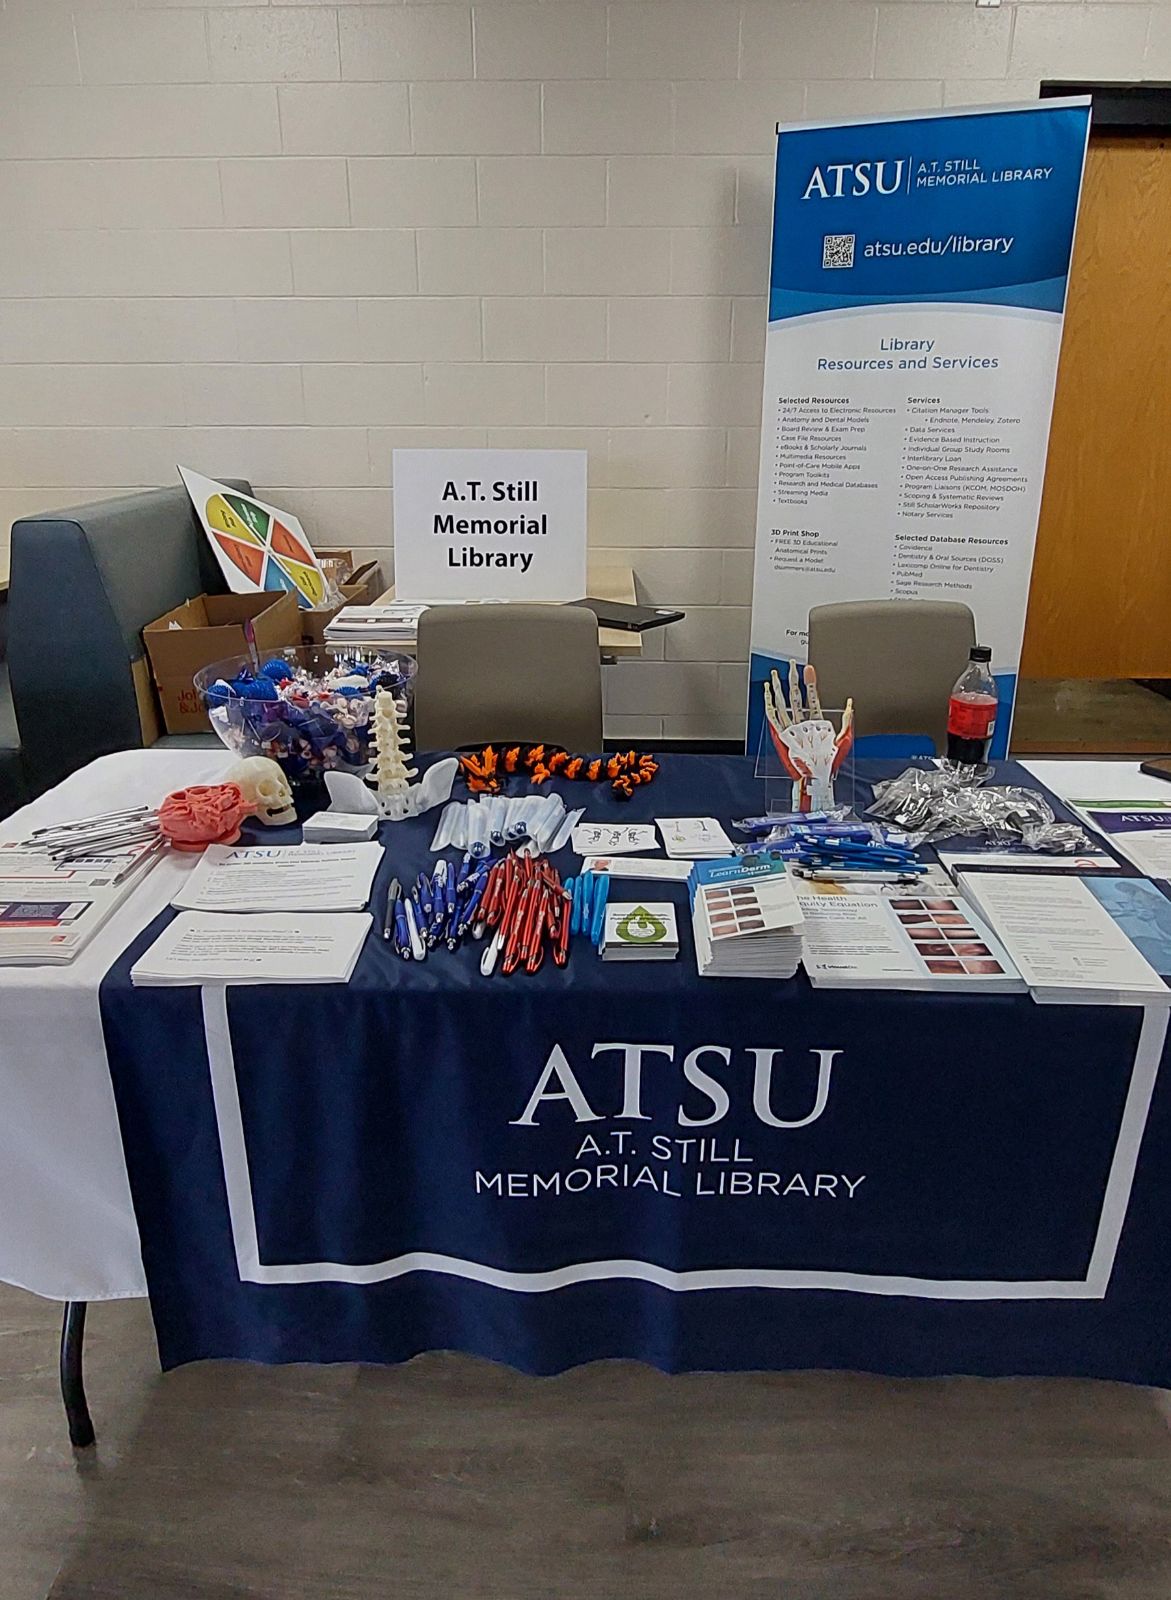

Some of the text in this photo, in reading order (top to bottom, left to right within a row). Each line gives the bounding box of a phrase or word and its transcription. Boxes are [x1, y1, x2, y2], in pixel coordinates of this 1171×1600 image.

[917, 159, 981, 174] A.T. STILL
[800, 159, 905, 200] ATSU
[916, 167, 1053, 188] MEMORIAL LIBRARY
[863, 234, 1014, 258] atsu.edu/library
[880, 338, 935, 352] Library
[817, 355, 999, 371] Resources and Services
[442, 481, 538, 501] A.T. Still
[976, 494, 1004, 502] Reviews
[433, 514, 547, 535] Memorial
[801, 530, 820, 538] Shop
[895, 534, 1008, 545] Selected Database Resources
[448, 547, 533, 573] Library
[978, 556, 1004, 564] (DOSS)
[963, 565, 994, 573] Dentistry
[226, 849, 282, 859] ATSU
[710, 864, 771, 878] LearnDerm
[508, 1043, 844, 1128] ATSU
[575, 1131, 754, 1163] A.T. STILL
[475, 1164, 866, 1199] MEMORIAL LIBRARY
